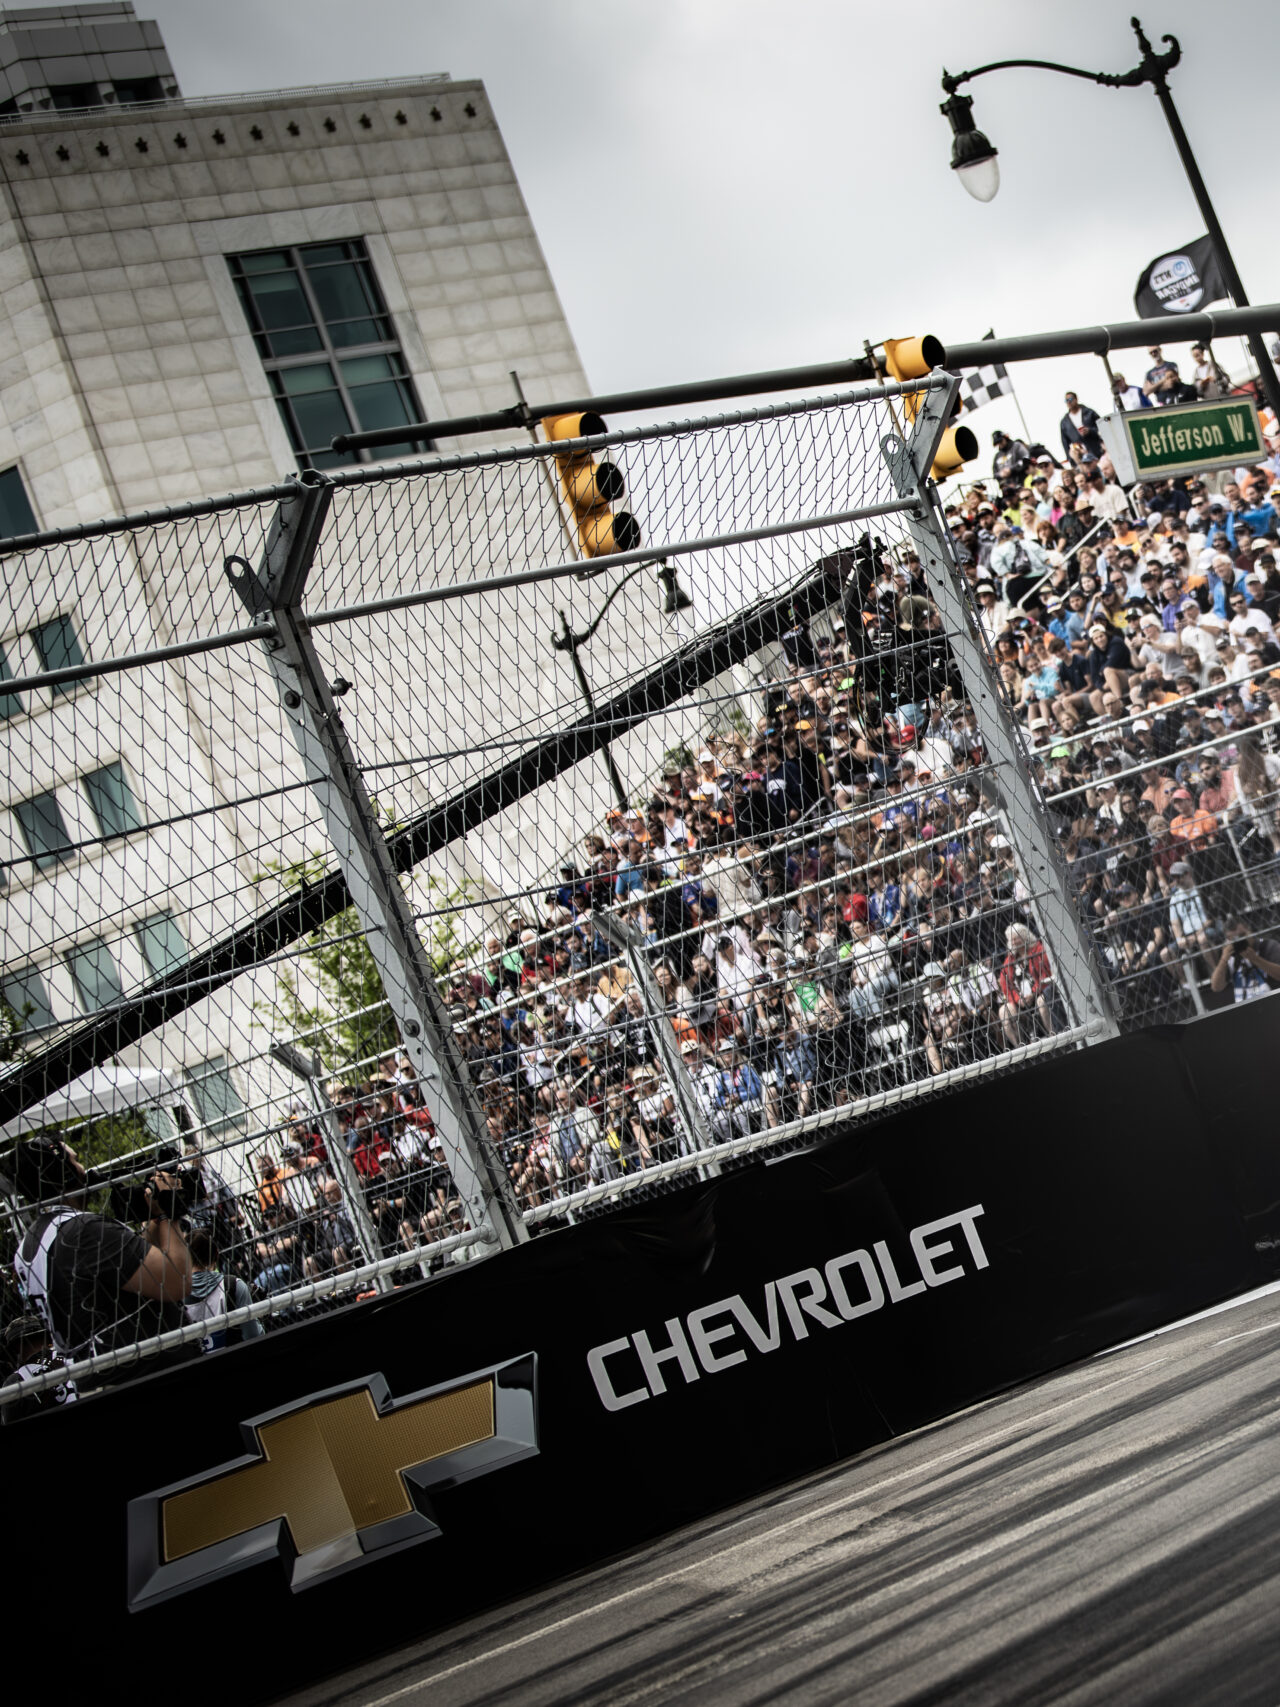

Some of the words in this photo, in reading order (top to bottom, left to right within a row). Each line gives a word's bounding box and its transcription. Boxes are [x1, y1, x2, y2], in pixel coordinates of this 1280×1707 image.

[1141, 424, 1224, 456] Jefferson
[1227, 413, 1253, 442] W.
[587, 1204, 990, 1412] CHEVROLET
